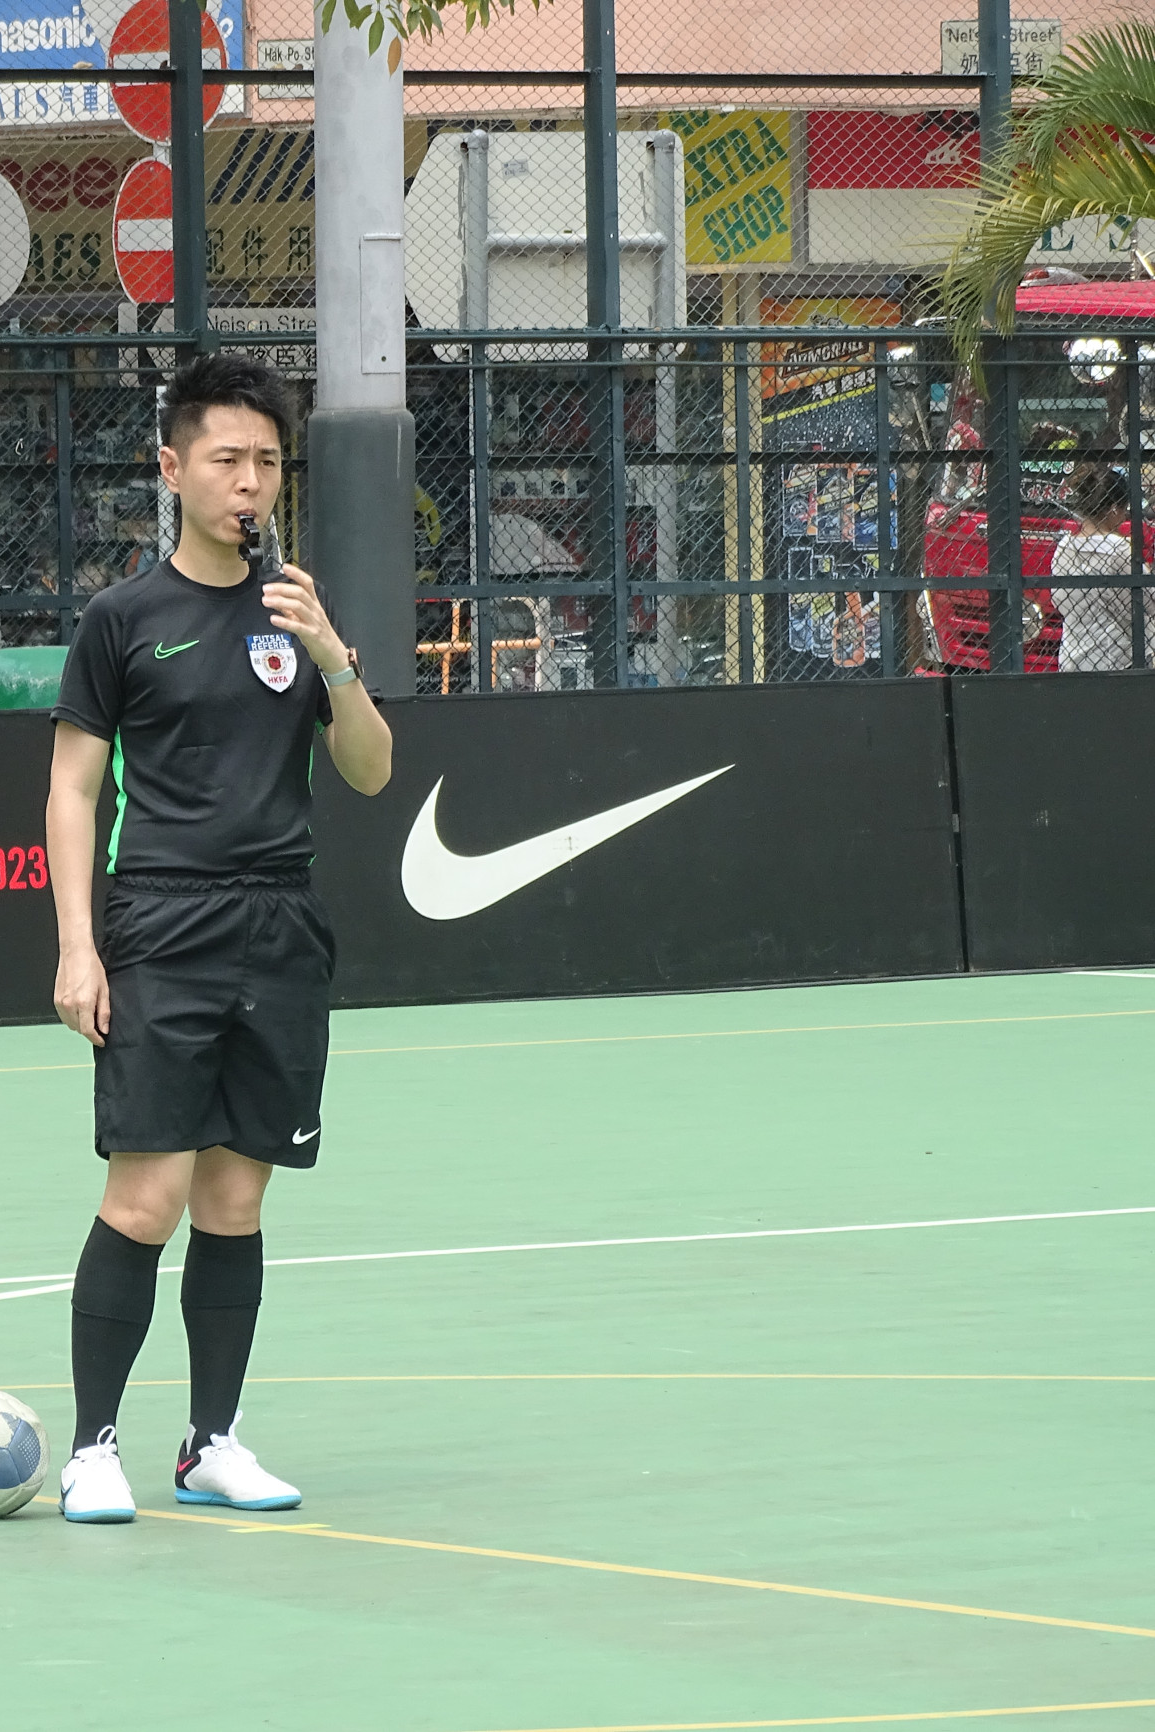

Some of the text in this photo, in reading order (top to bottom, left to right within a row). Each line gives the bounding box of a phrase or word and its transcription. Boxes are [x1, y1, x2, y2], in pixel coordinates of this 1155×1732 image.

[1010, 27, 1054, 43] Street
[265, 47, 283, 61] Hak
[288, 47, 299, 61] Po
[961, 52, 1044, 75] 奶臣街
[704, 185, 788, 261] SHOP
[26, 232, 102, 281] AES
[207, 313, 270, 332] Nelson
[251, 640, 291, 651] REFEREE
[252, 633, 287, 644] FUTSAL
[267, 675, 288, 684] HKFA
